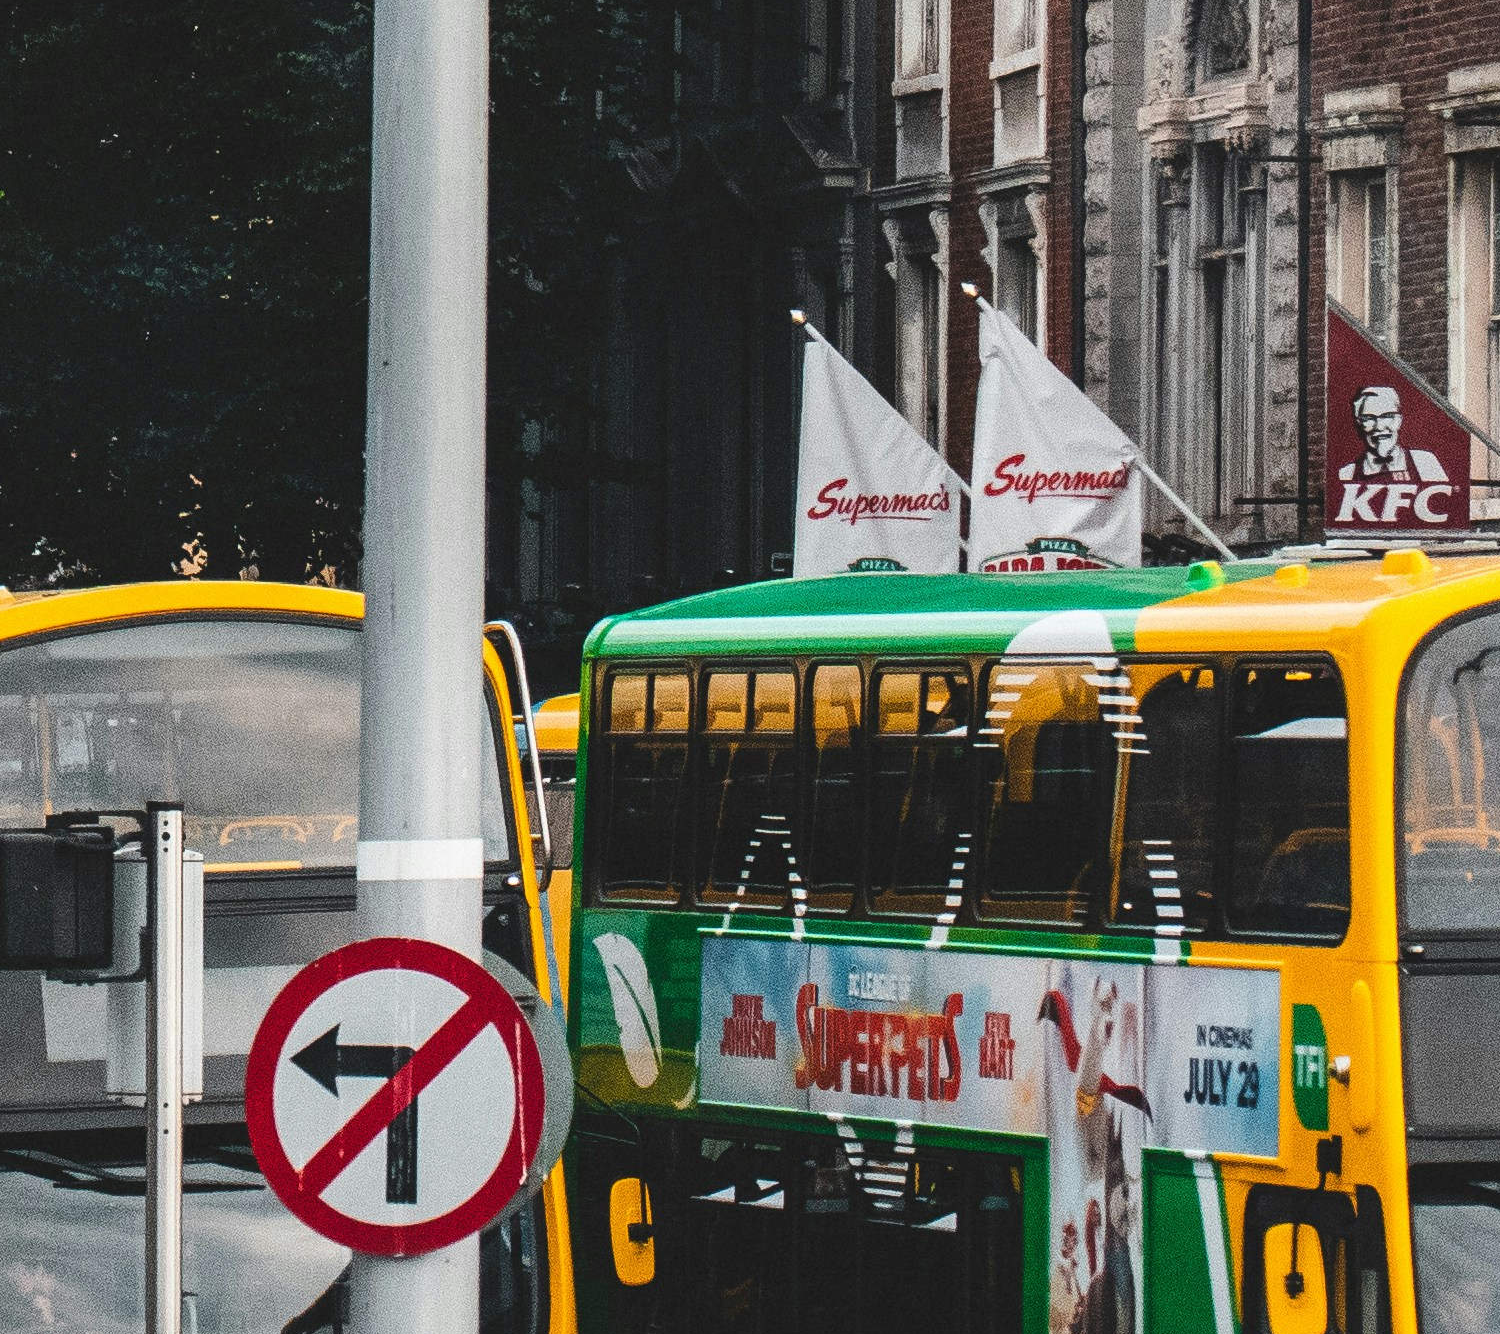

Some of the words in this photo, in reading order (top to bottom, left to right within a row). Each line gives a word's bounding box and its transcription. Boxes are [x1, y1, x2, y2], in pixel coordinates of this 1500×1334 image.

[808, 477, 951, 526] Supermac's
[1333, 483, 1453, 523] KFC
[1184, 1057, 1232, 1106] JULY
[1236, 1060, 1259, 1109] 29
[1295, 1045, 1325, 1088] TFI
